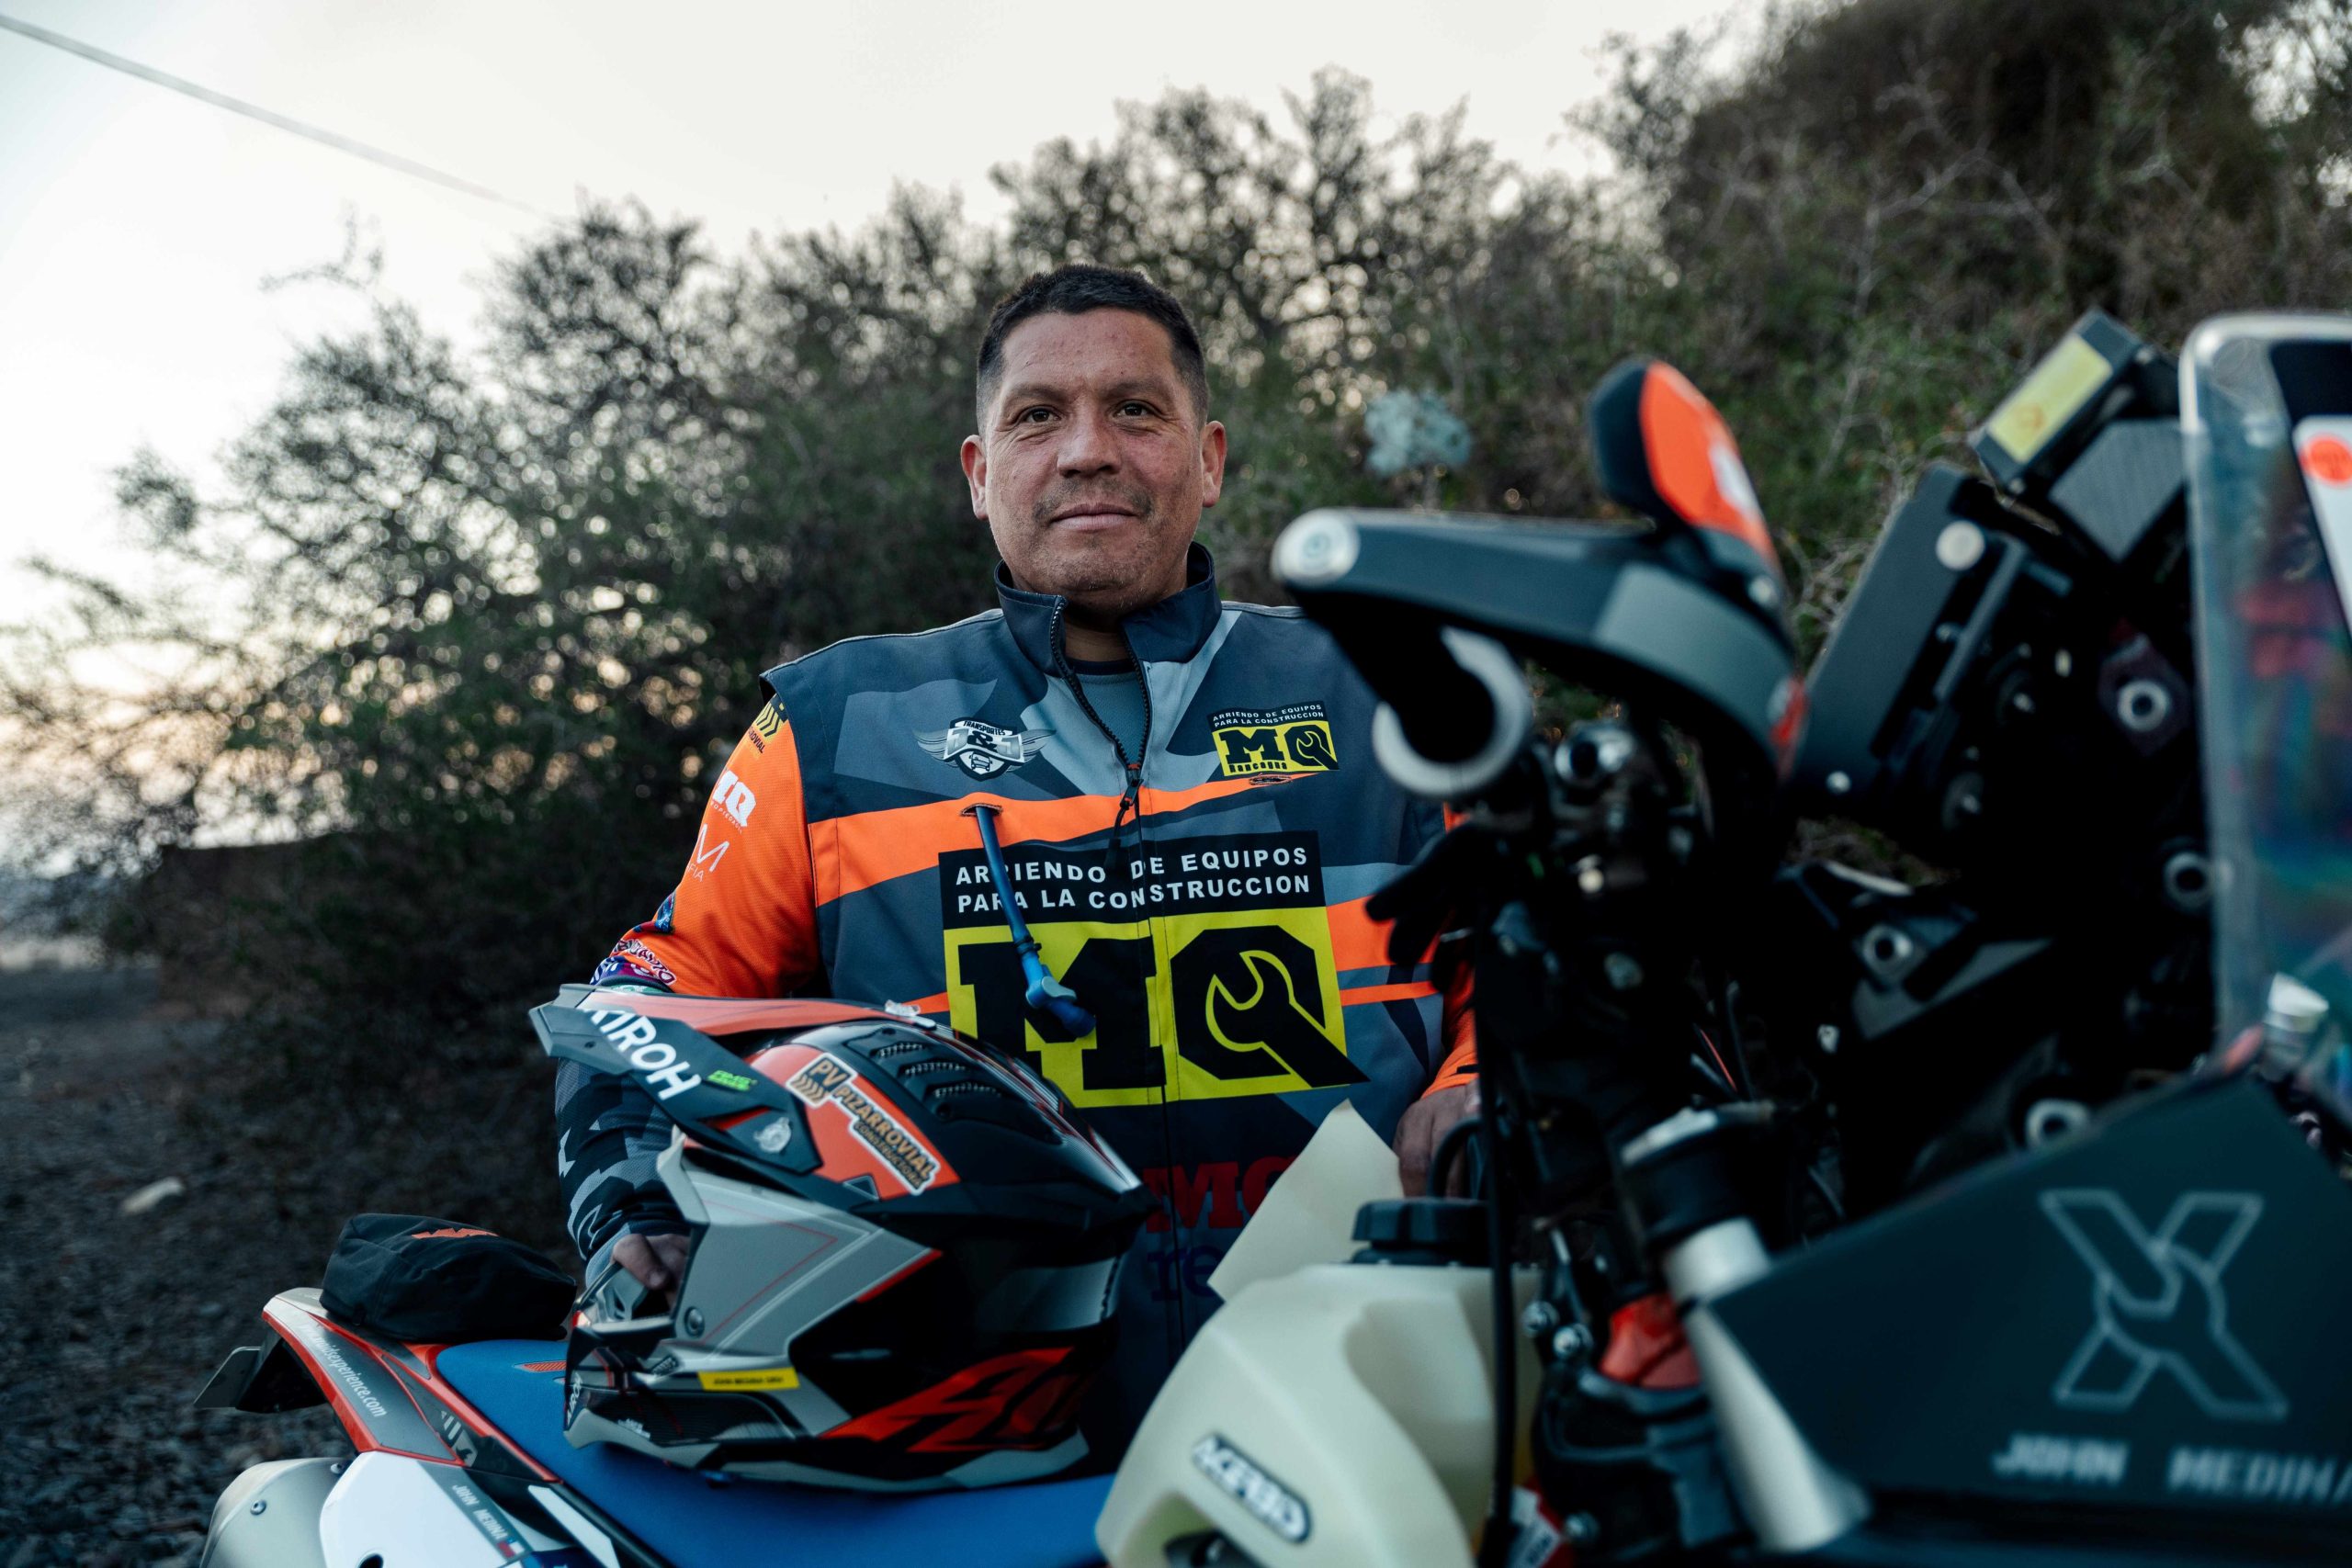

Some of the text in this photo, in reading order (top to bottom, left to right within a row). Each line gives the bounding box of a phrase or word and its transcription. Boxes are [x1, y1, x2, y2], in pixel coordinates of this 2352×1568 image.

[963, 720, 1005, 735] TRANSPORTES
[1213, 712, 1259, 721] ARRIENDO
[1282, 705, 1321, 715] EQUIPOS
[1215, 718, 1238, 728] PARA
[1255, 712, 1324, 724] CONSTRUCCION
[956, 847, 1307, 885] ARIENDO DE EQUIPOS
[1041, 888, 1075, 908] LA
[1089, 875, 1309, 908] CONSTRUCCION
[809, 1059, 847, 1087] PV
[834, 1086, 935, 1179] PIZARROVIAL
[452, 1484, 508, 1540] JOHN MEDINA
